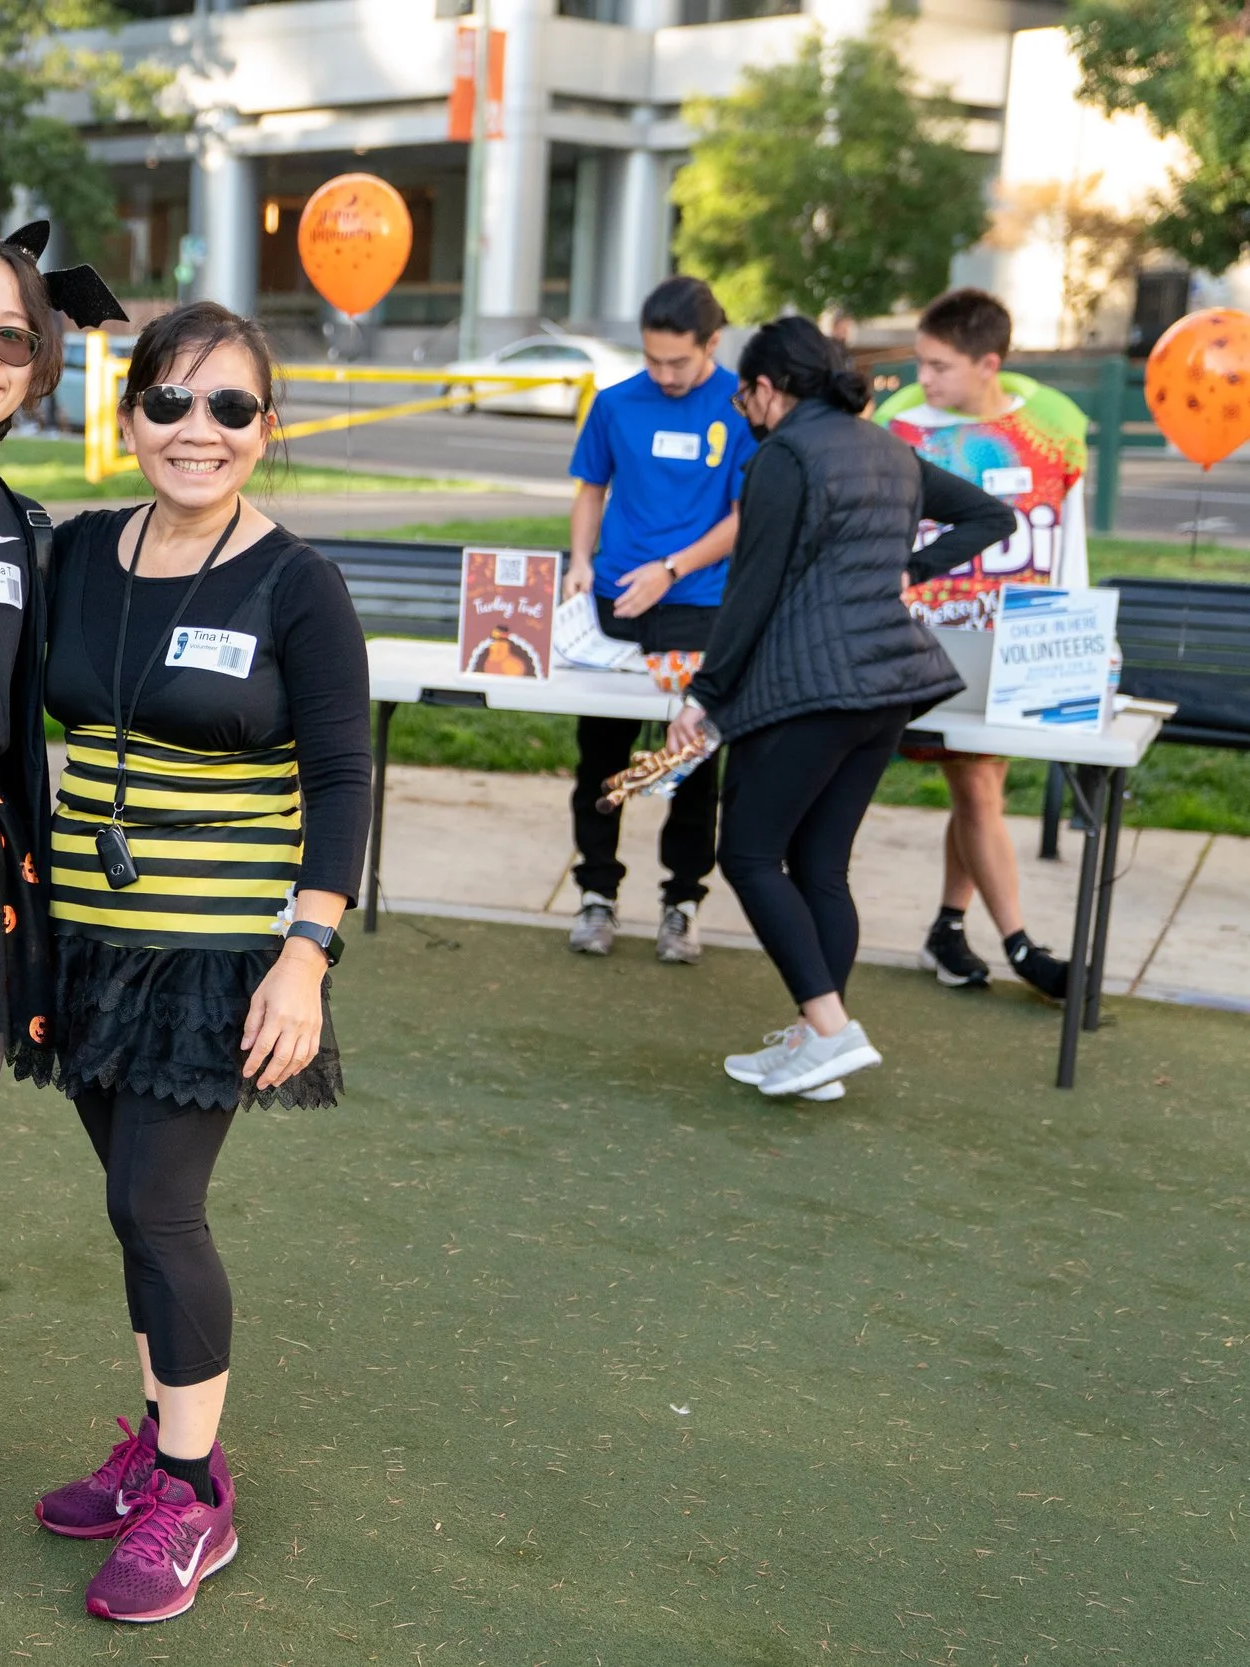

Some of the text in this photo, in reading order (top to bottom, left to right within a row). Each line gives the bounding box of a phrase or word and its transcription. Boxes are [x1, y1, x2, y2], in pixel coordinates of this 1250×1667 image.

[194, 631, 216, 642] Tina
[1010, 615, 1097, 640] CHECK IN HERE
[1000, 634, 1107, 665] VOLUNTEERS
